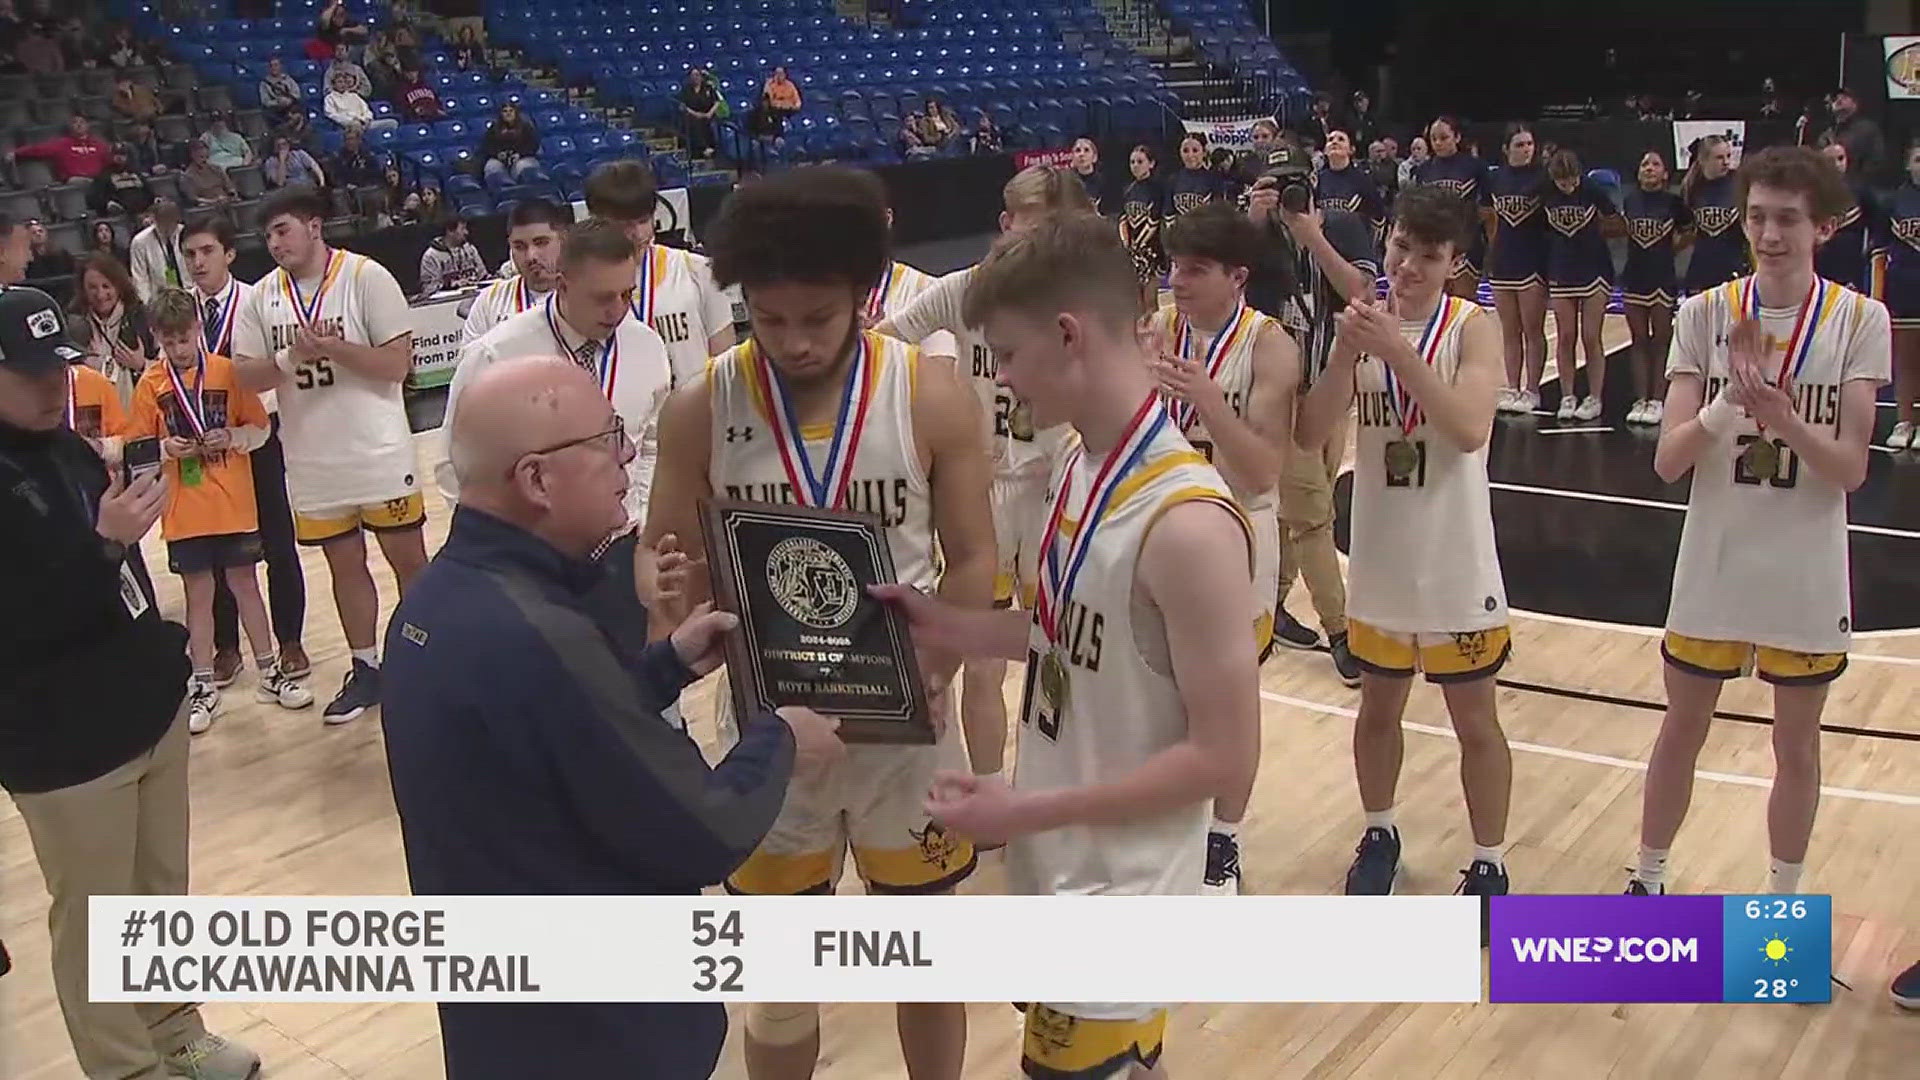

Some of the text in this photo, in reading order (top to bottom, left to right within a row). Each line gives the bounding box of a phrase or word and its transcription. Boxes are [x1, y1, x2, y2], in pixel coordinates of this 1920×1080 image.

[411, 334, 440, 349] Find
[413, 352, 444, 366] from
[295, 357, 335, 390] 55
[815, 683, 893, 695] BASKETBALL
